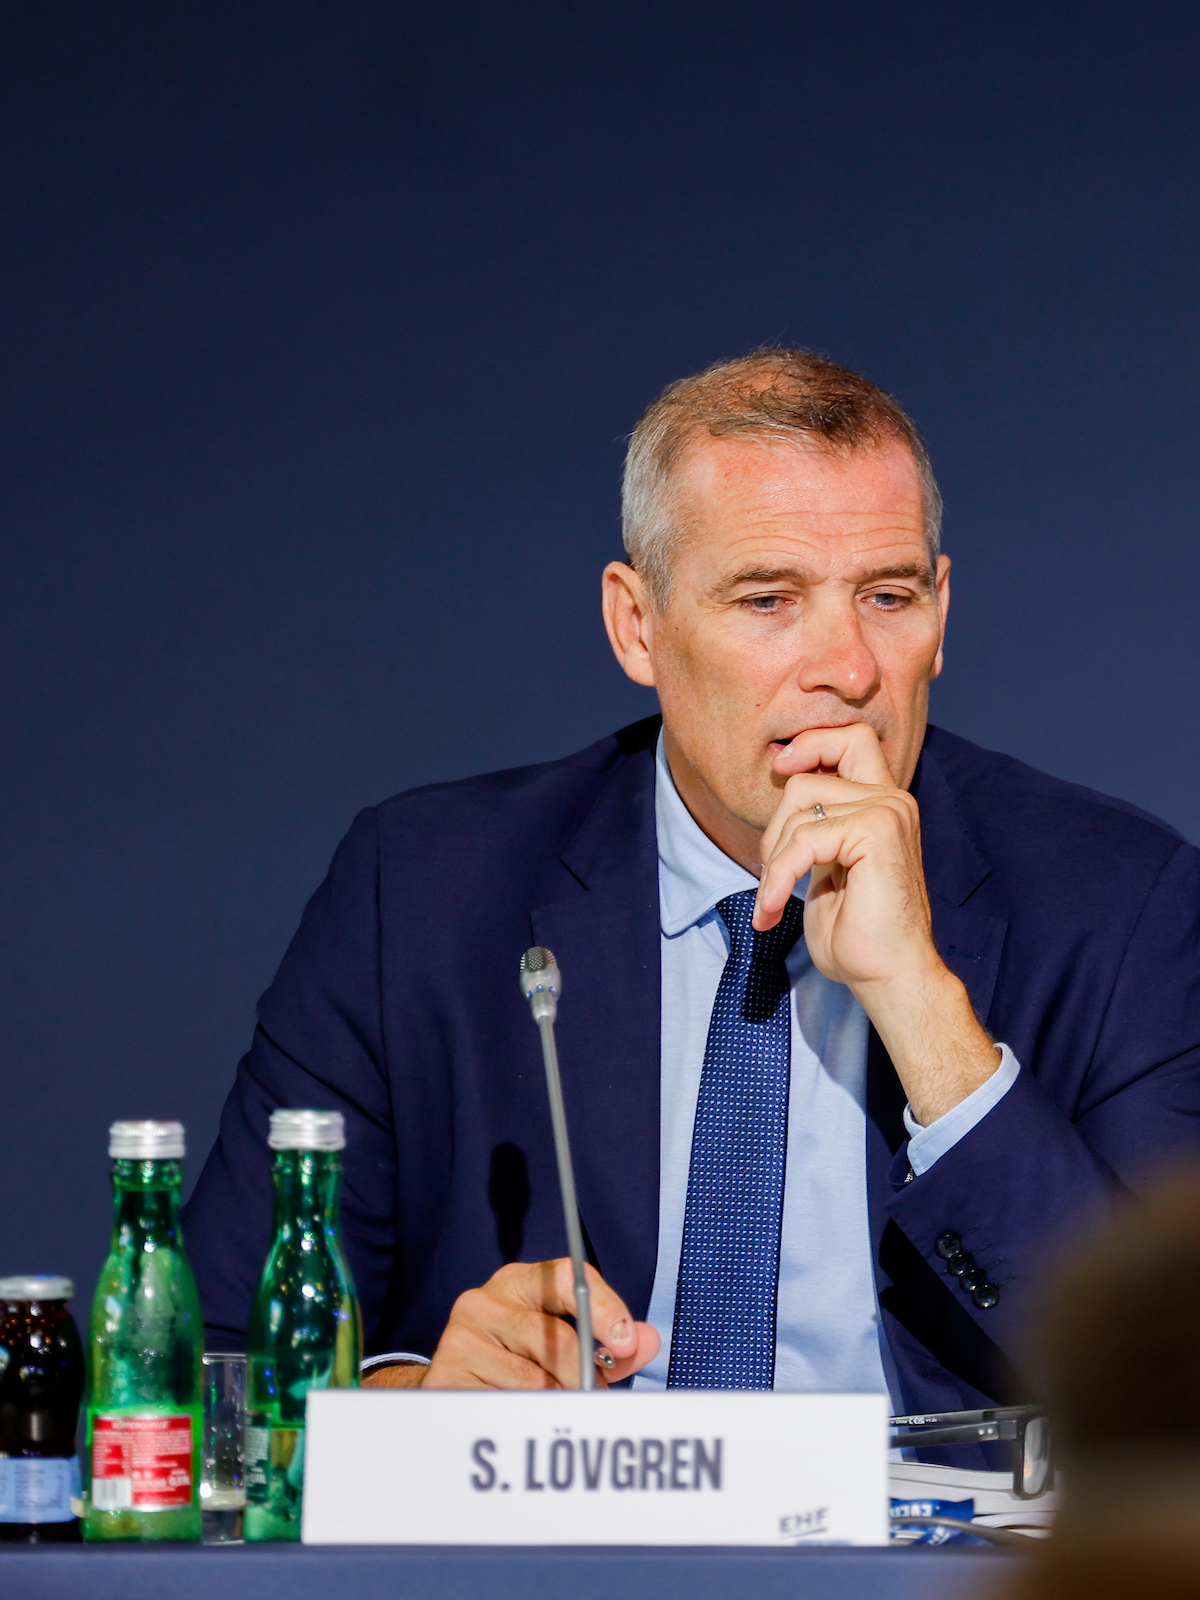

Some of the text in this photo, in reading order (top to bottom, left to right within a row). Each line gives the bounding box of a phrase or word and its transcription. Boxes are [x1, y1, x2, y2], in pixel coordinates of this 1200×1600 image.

[471, 1427, 724, 1492] S. LÖVGREN
[779, 1507, 829, 1535] EHF
